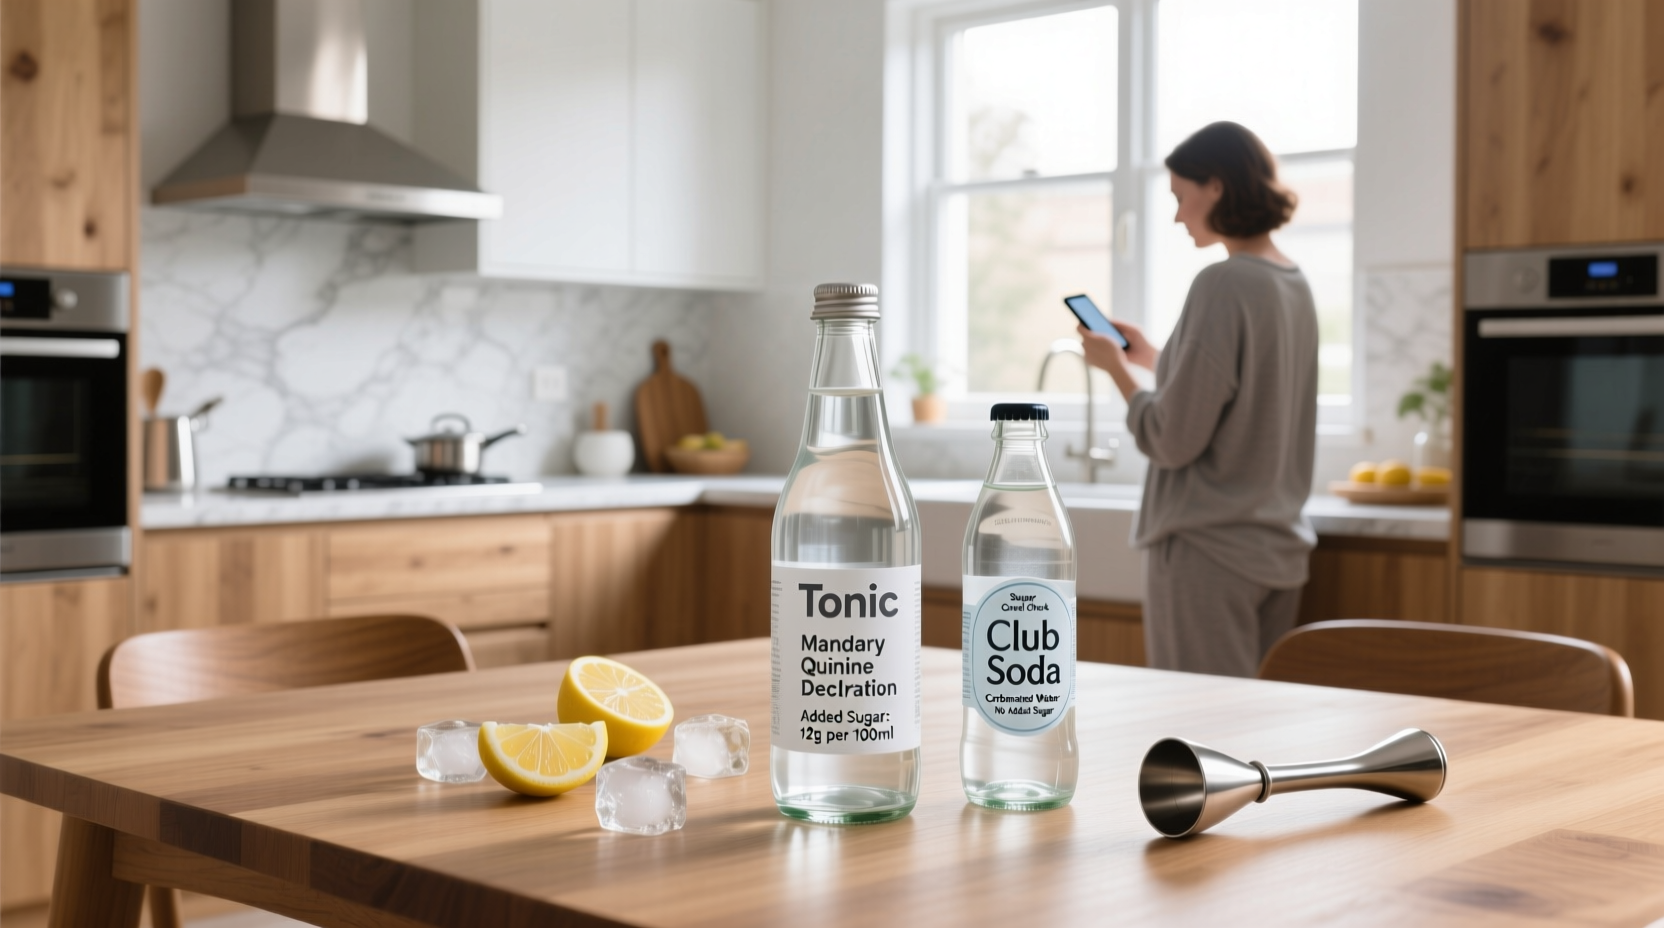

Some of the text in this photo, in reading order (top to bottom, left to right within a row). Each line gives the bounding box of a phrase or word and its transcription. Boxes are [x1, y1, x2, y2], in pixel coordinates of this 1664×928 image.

[798, 582, 899, 619] Tonic
[801, 634, 886, 657] Mandary
[986, 619, 1060, 651] Club
[801, 656, 874, 677] Quinine
[986, 654, 1061, 686] Soda
[800, 709, 890, 727] Added Sugar:
[800, 725, 894, 744] 12g per 100ml
